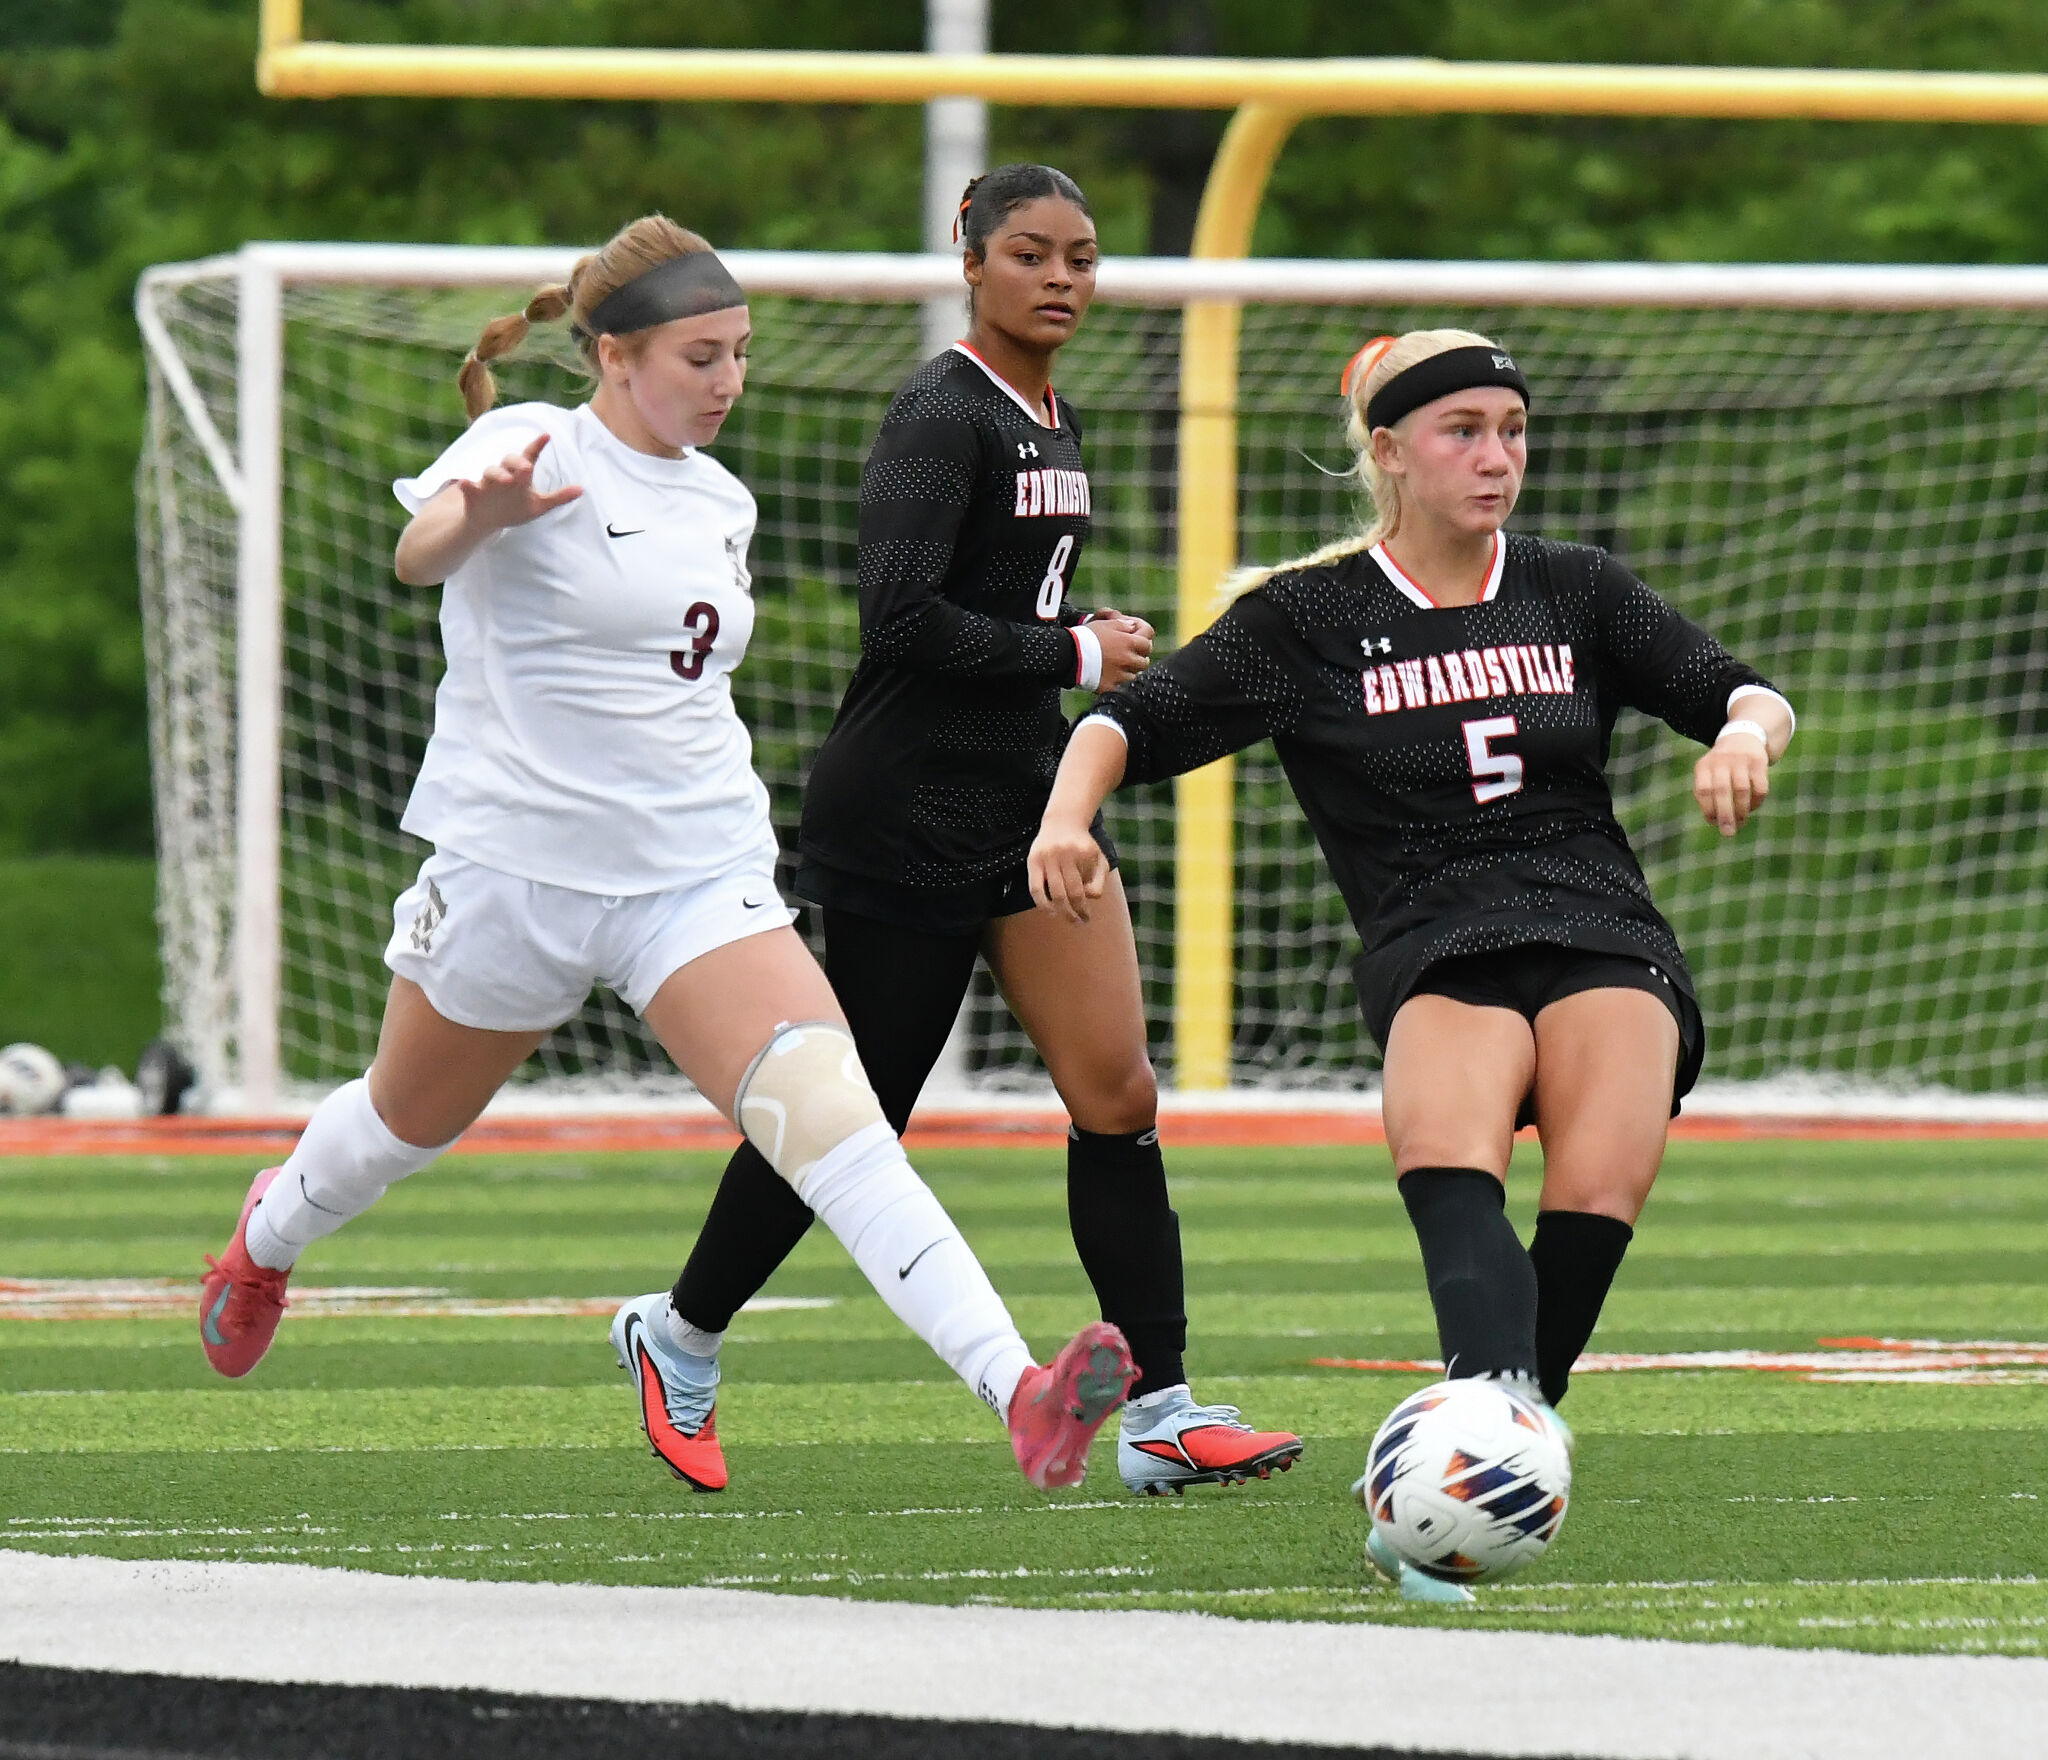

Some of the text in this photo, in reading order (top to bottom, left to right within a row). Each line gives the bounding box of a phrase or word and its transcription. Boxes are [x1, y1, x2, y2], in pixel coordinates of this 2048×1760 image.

[1036, 534, 1074, 620] 8
[670, 601, 720, 682] 3
[1361, 644, 1575, 716] EDWARDSVILLE
[1461, 715, 1525, 805] 5
